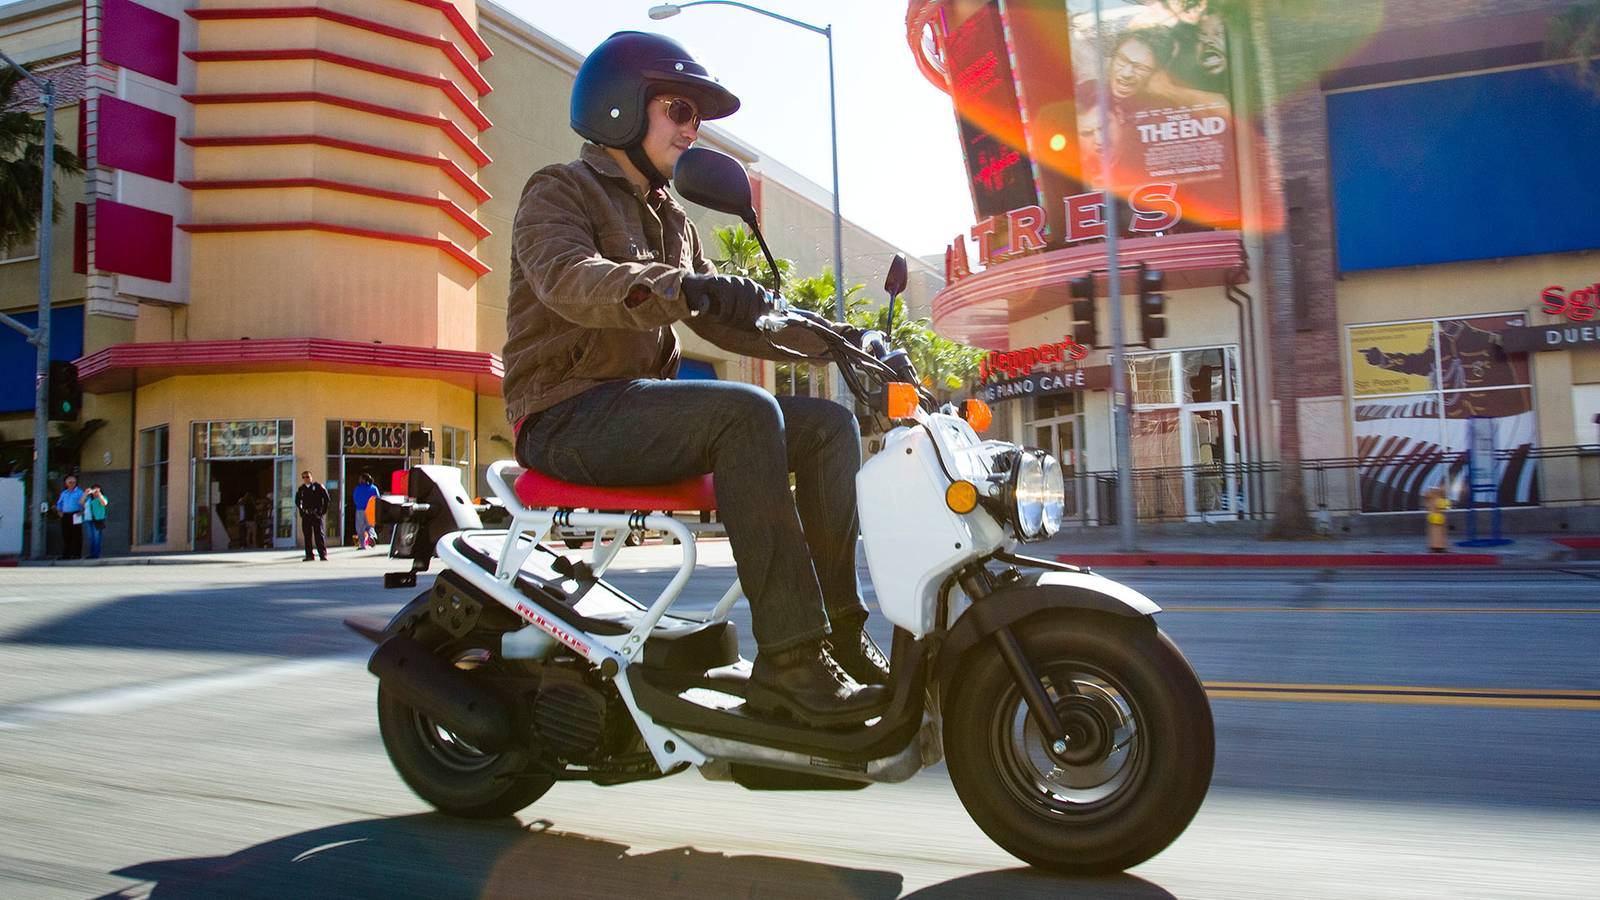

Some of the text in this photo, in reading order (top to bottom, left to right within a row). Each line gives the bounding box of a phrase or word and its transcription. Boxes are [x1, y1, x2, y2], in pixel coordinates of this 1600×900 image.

[945, 183, 1182, 287] ATRES
[343, 426, 405, 449] BOOKS
[515, 601, 591, 656] RUCKUS
